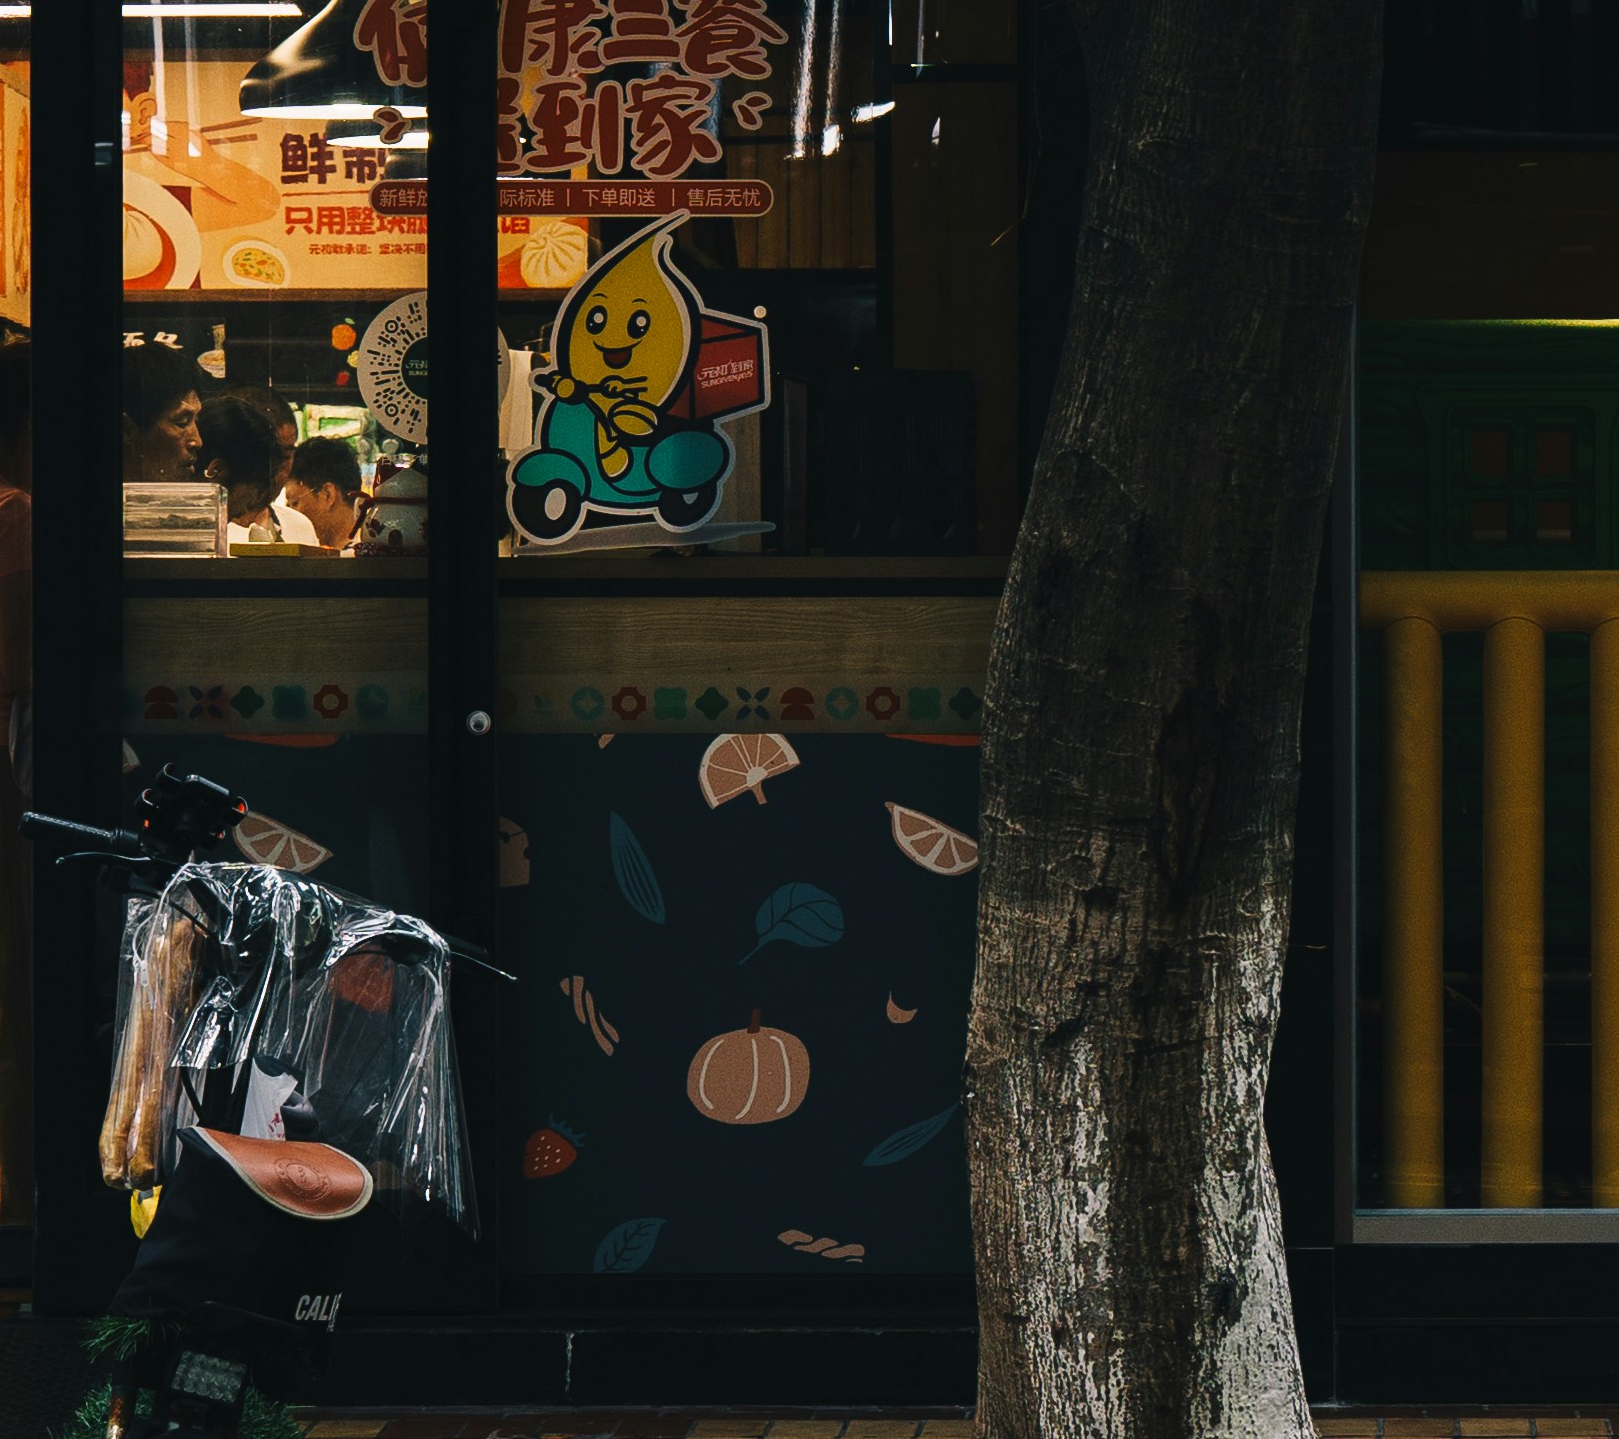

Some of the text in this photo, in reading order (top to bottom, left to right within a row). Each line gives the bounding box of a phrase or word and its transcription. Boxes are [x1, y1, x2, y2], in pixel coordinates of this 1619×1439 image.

[379, 188, 761, 208] 新鲜放 际标准 下单即送 售后无忧
